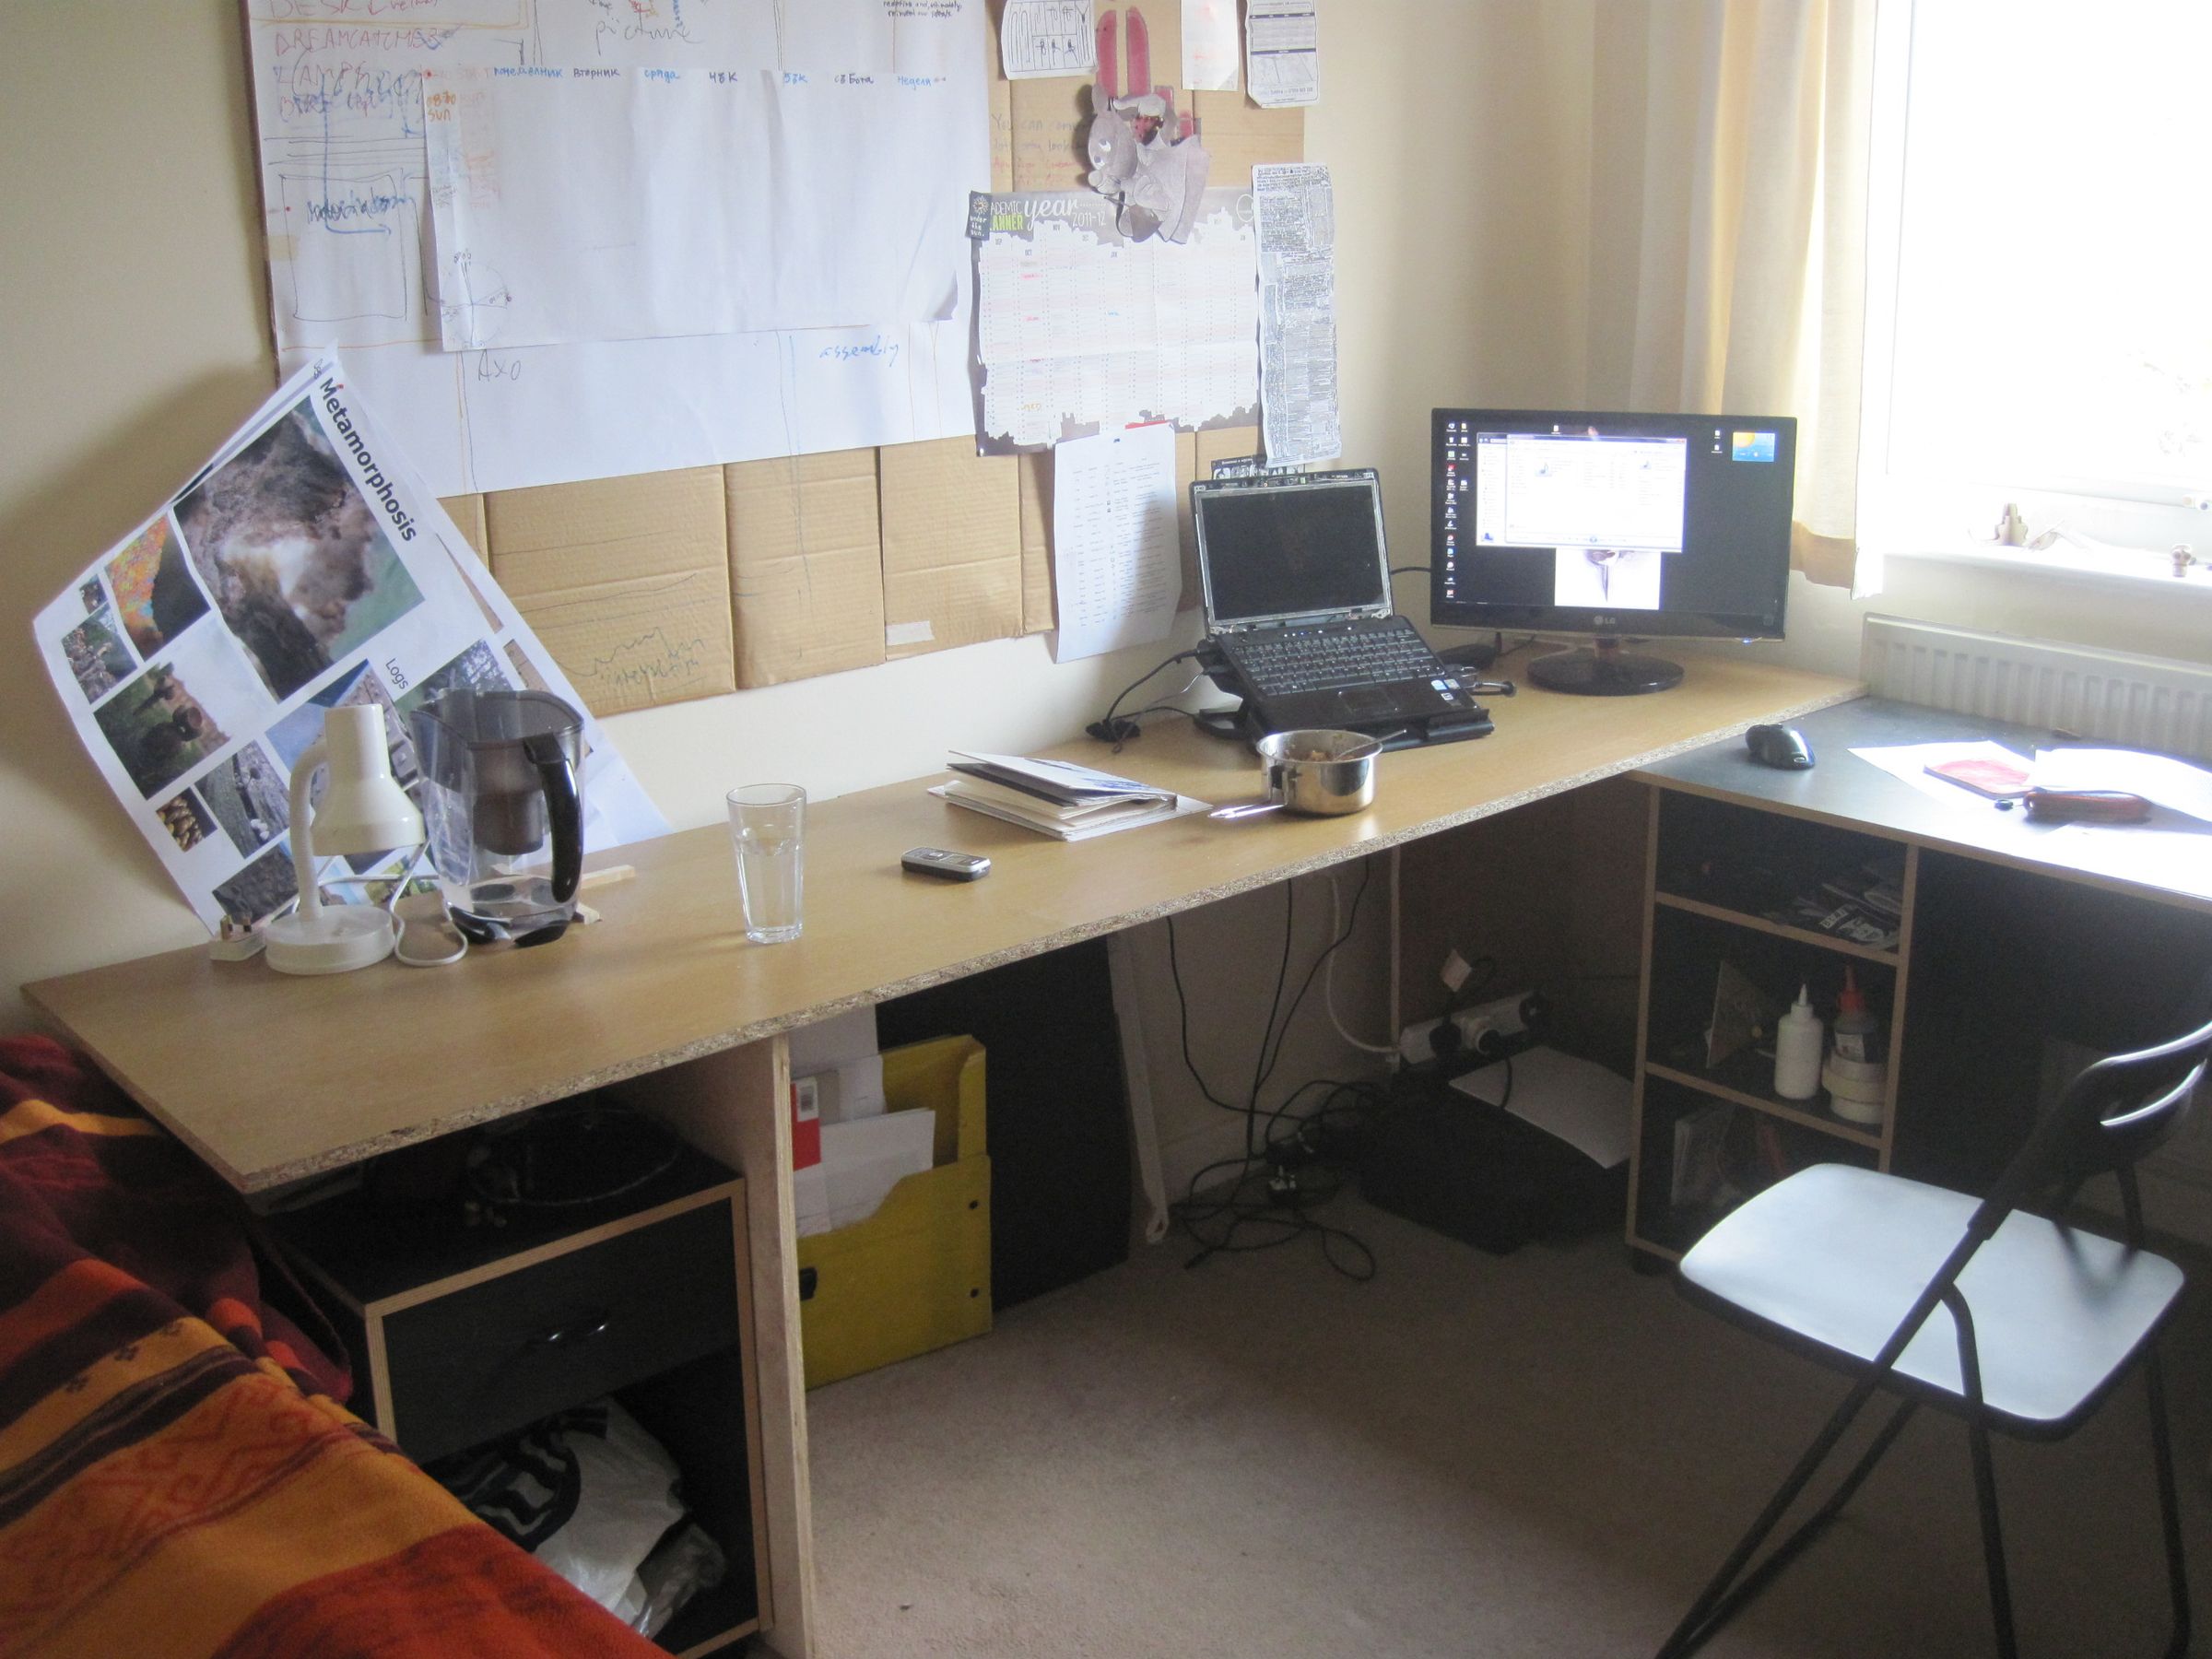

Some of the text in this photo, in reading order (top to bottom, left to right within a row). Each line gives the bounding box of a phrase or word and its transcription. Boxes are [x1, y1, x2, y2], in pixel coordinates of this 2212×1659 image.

[1024, 198, 1078, 230] year
[1072, 210, 1107, 227] 2011-12
[319, 376, 418, 542] Metamorphosis
[384, 656, 409, 690] Logs
